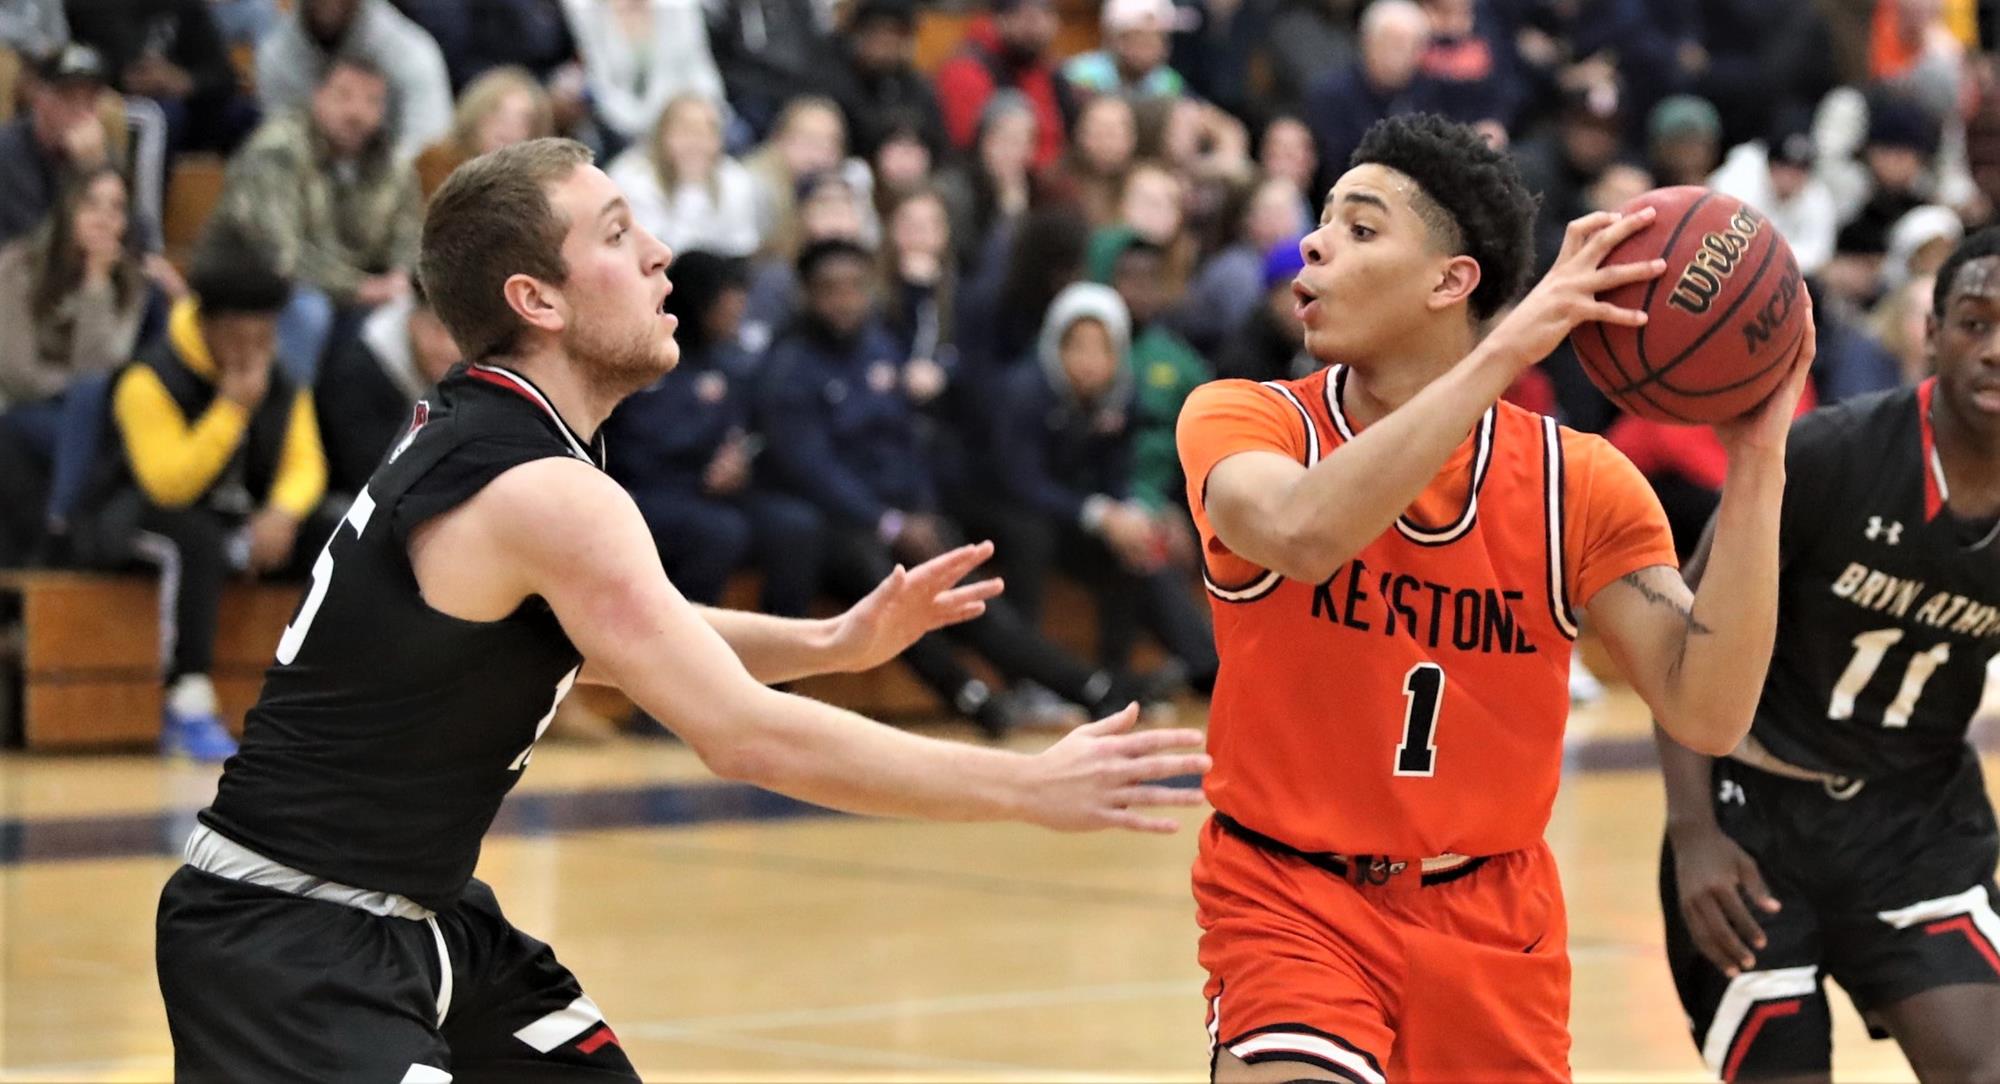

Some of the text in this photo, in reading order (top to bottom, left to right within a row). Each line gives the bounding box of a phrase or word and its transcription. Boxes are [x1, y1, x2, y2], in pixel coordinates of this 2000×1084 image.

[1831, 562, 1925, 617] BRYN
[1393, 661, 1445, 777] 1
[1827, 627, 1951, 728] 11
